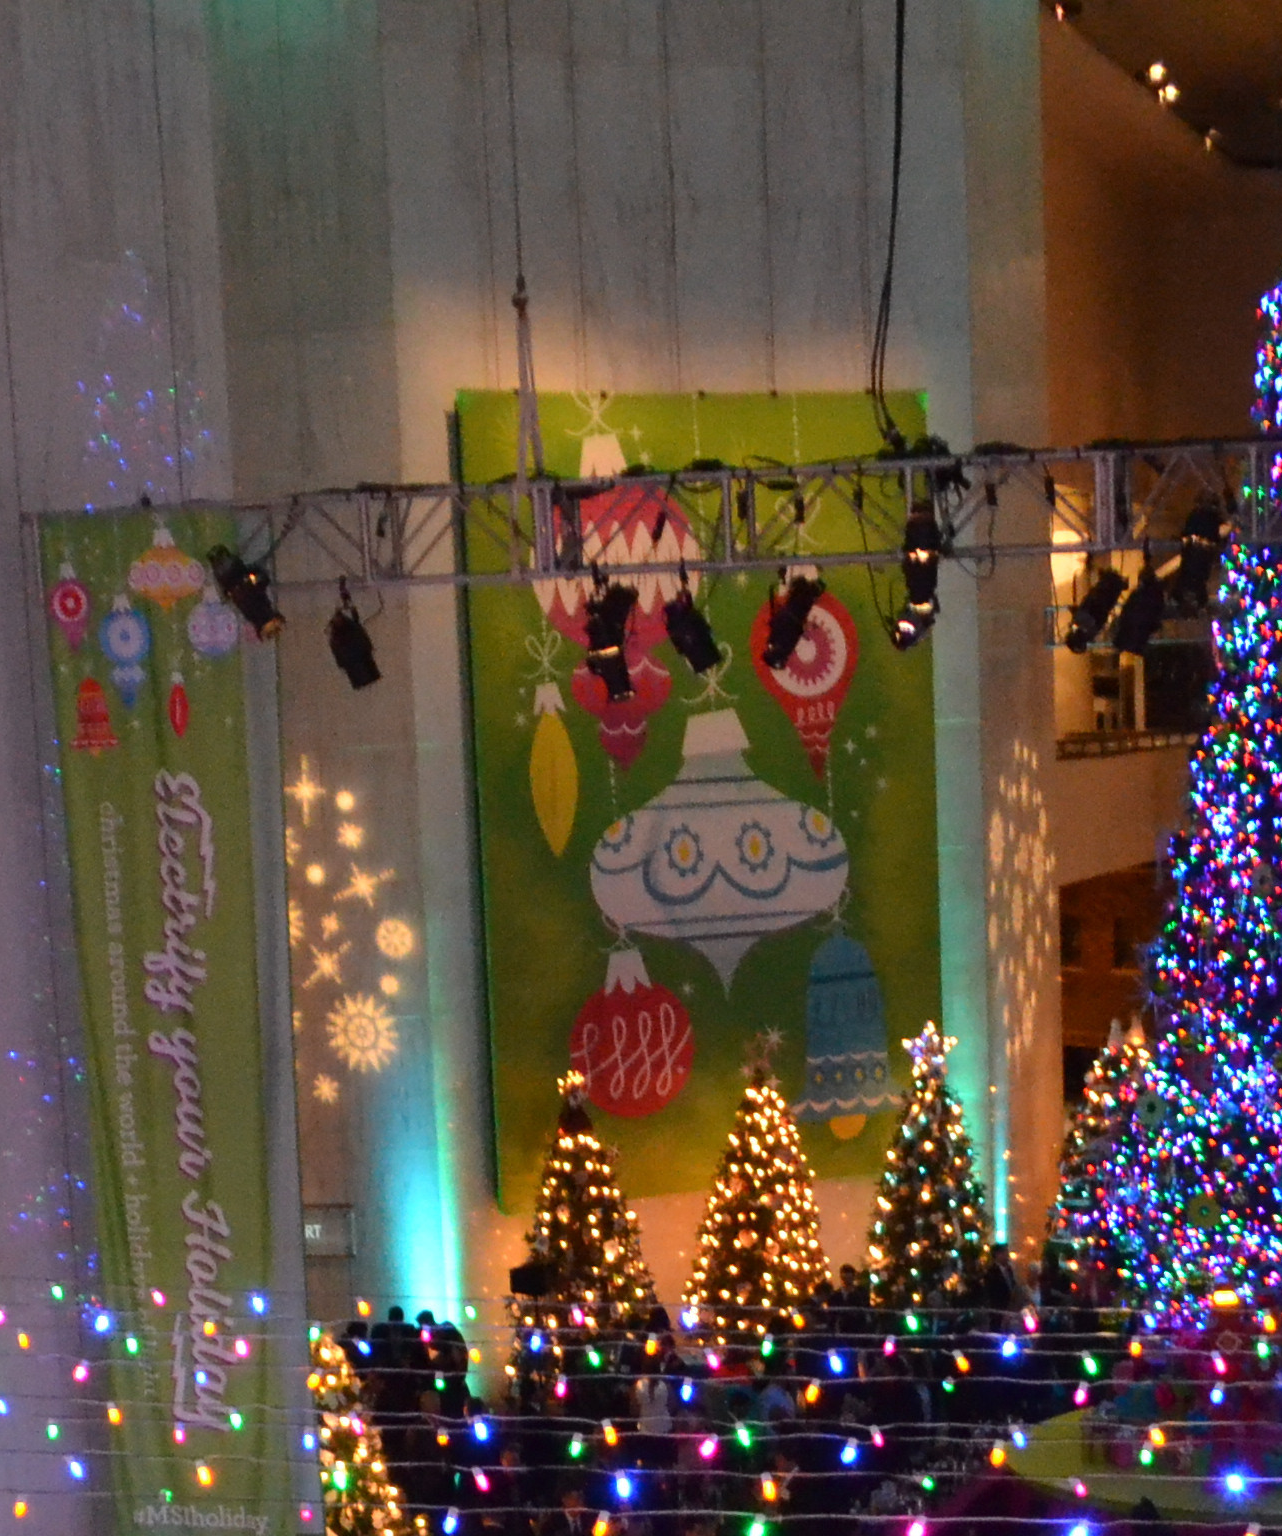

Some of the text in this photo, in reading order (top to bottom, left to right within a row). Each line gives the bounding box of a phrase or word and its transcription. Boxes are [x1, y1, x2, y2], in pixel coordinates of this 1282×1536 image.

[115, 1042, 139, 1088] the
[142, 768, 232, 1432] Electrify your Holiday
[120, 1092, 146, 1167] world
[124, 1194, 152, 1299] holidays
[132, 1504, 269, 1536] #MSIholiday
